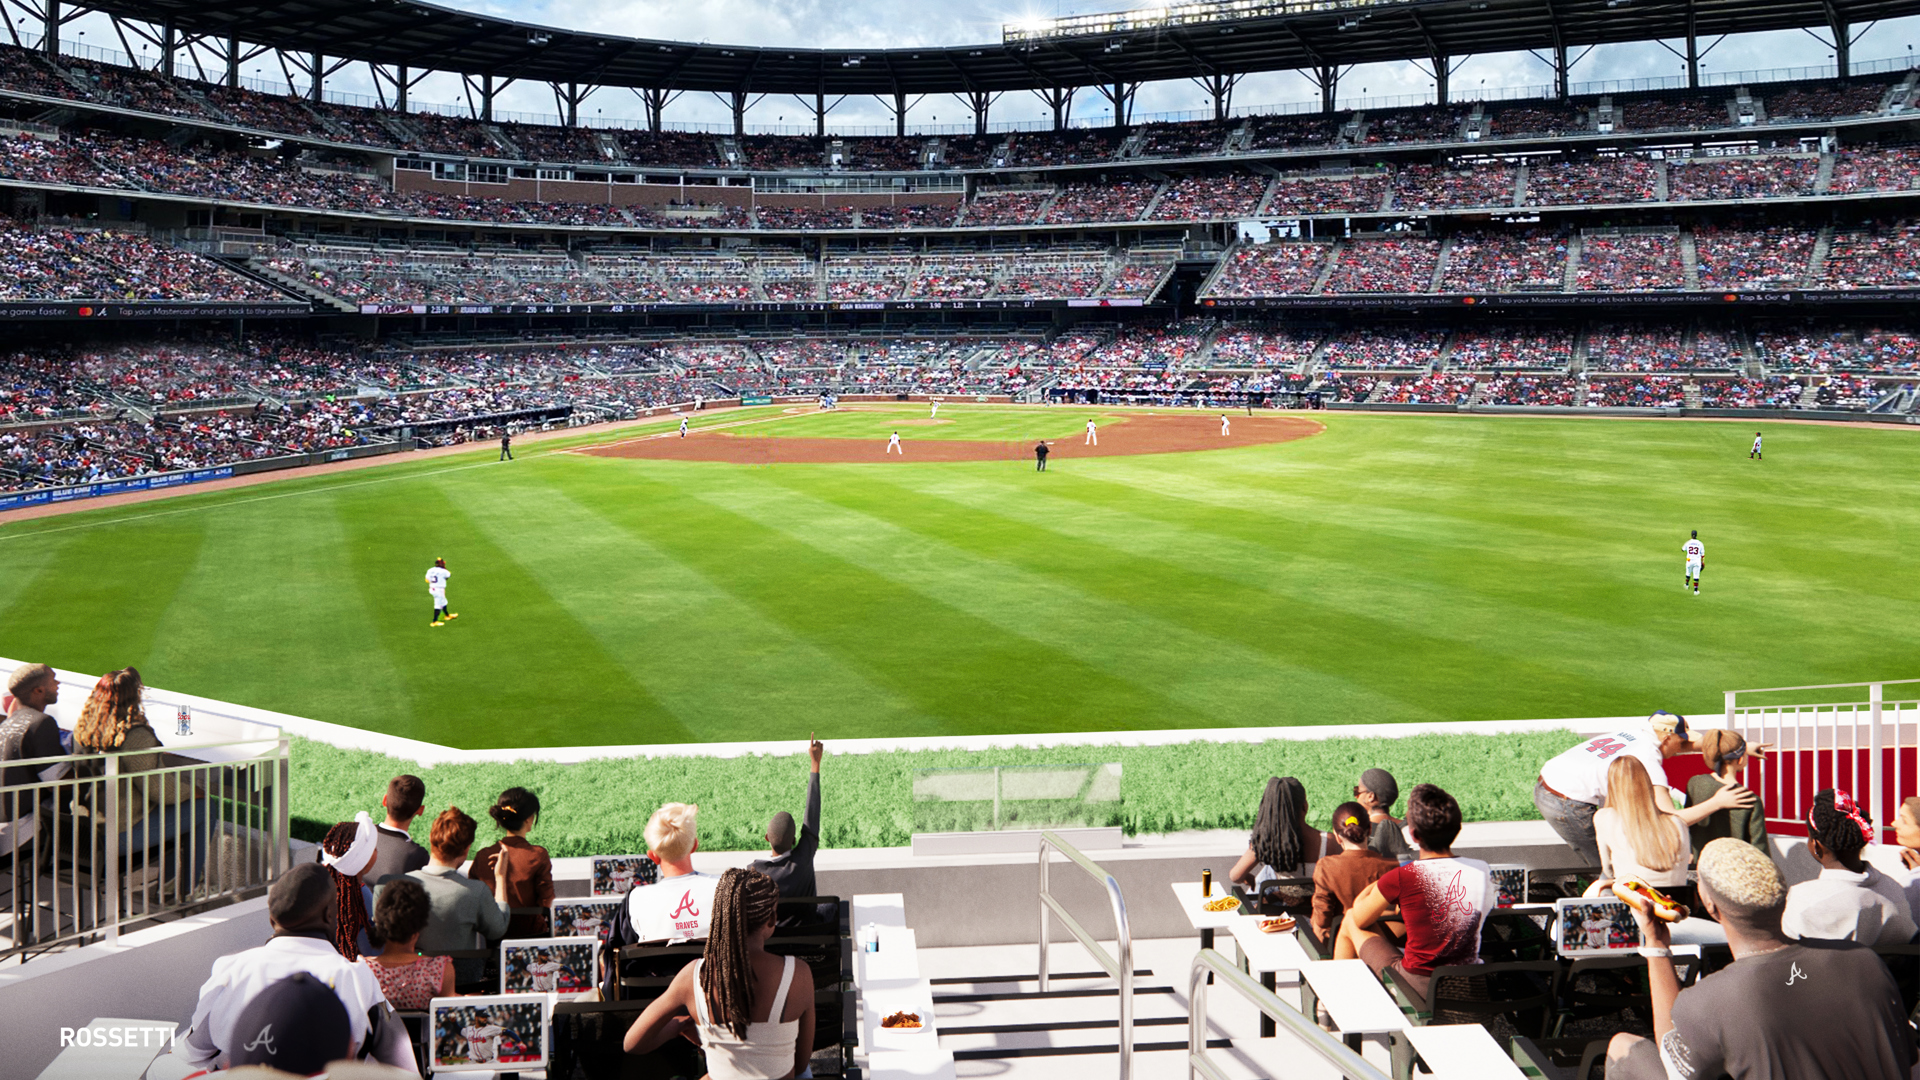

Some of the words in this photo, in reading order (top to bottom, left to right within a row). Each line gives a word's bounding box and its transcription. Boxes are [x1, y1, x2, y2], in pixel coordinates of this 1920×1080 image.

[1739, 294, 1755, 302] Tap
[9, 308, 37, 318] game
[119, 307, 134, 317] Tap
[134, 309, 152, 317] your
[1688, 546, 1699, 555] 23
[1585, 737, 1627, 760] 44
[669, 888, 700, 920] A
[674, 920, 699, 931] BRAVES
[1785, 961, 1808, 986] A
[243, 1023, 277, 1056] A
